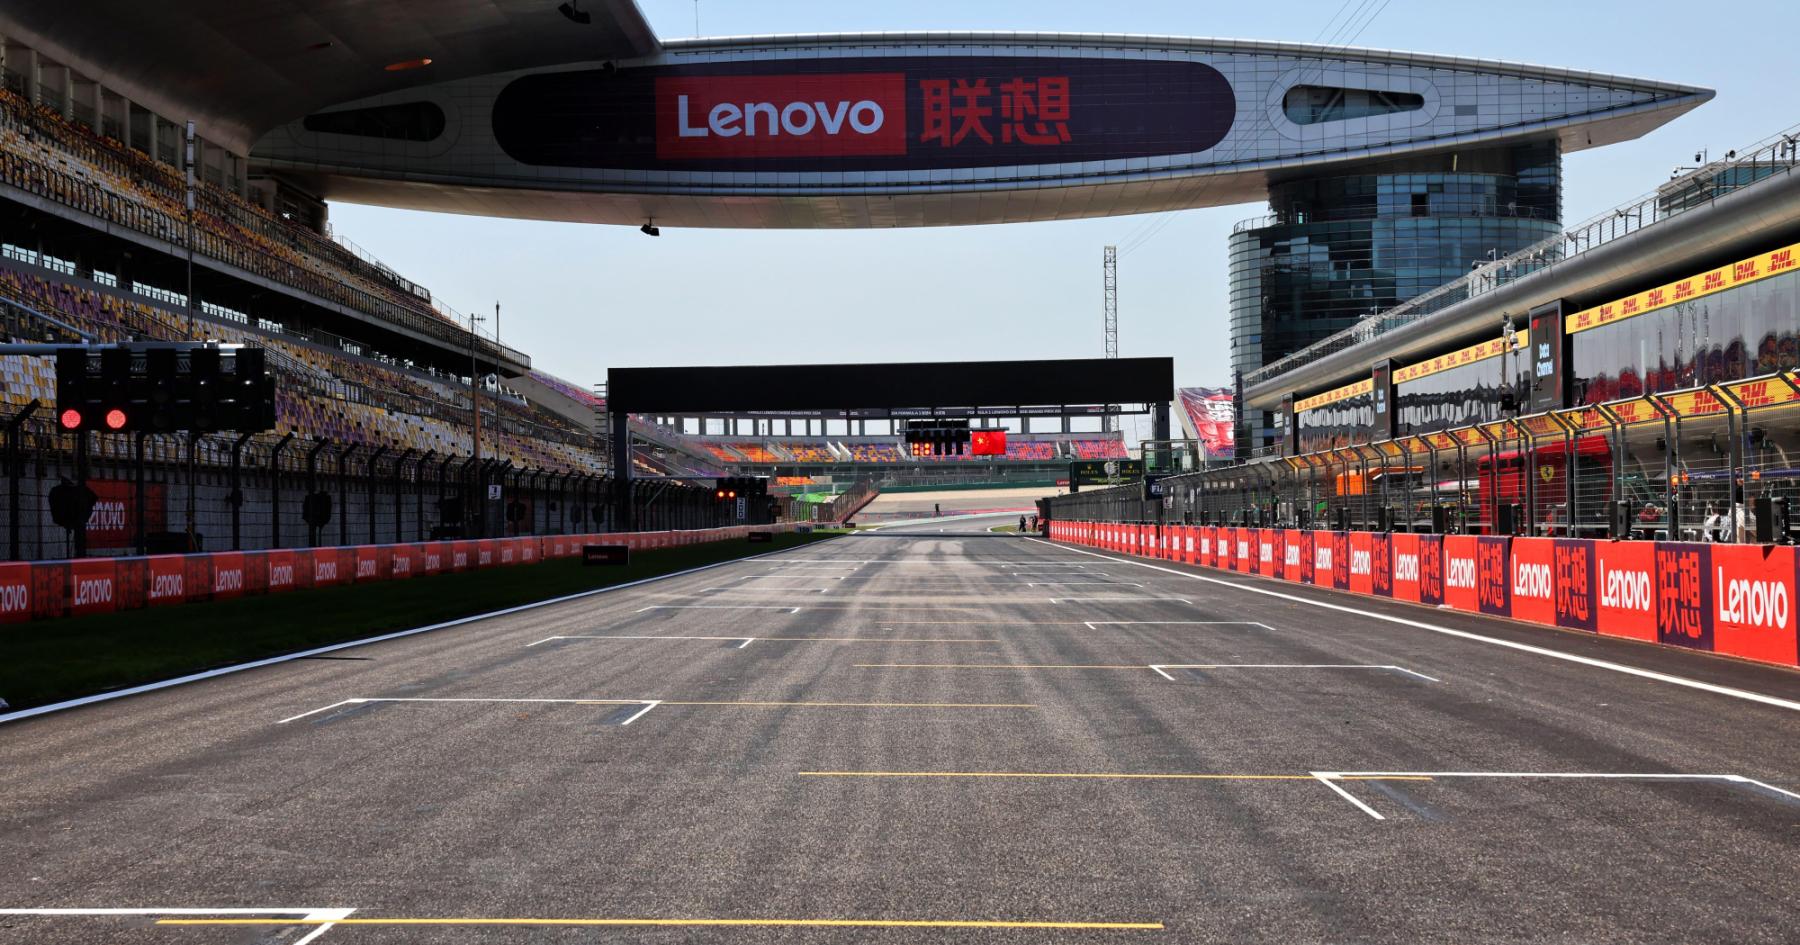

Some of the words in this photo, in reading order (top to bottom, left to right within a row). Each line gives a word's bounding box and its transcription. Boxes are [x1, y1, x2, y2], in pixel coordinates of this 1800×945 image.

[678, 95, 885, 137] Lenovo
[919, 76, 1073, 147] 联想
[1736, 261, 1757, 282] DHL
[1771, 250, 1793, 272] DHL
[1675, 281, 1693, 300] DHL
[1705, 272, 1724, 291] DHL
[1623, 298, 1640, 315] DHL
[1648, 290, 1664, 308] DHL
[1741, 382, 1769, 408] DHL
[86, 500, 126, 531] enovo
[1315, 542, 1332, 570] Lenovo
[1350, 543, 1371, 576] Lenovo
[1394, 547, 1419, 582] Lenovo
[150, 570, 183, 598] Lenovo
[215, 566, 242, 591] Lenovo
[269, 562, 292, 586] Lenovo
[1446, 550, 1476, 588] Lenovo
[1479, 543, 1505, 607] 联想
[1513, 553, 1552, 599] Lenovo
[1555, 546, 1589, 622] 联想
[0, 583, 27, 611] novo
[74, 575, 112, 605] Lenovo
[1600, 559, 1651, 612] Lenovo
[1657, 550, 1703, 639] 联想
[1718, 566, 1788, 629] Lenovo
